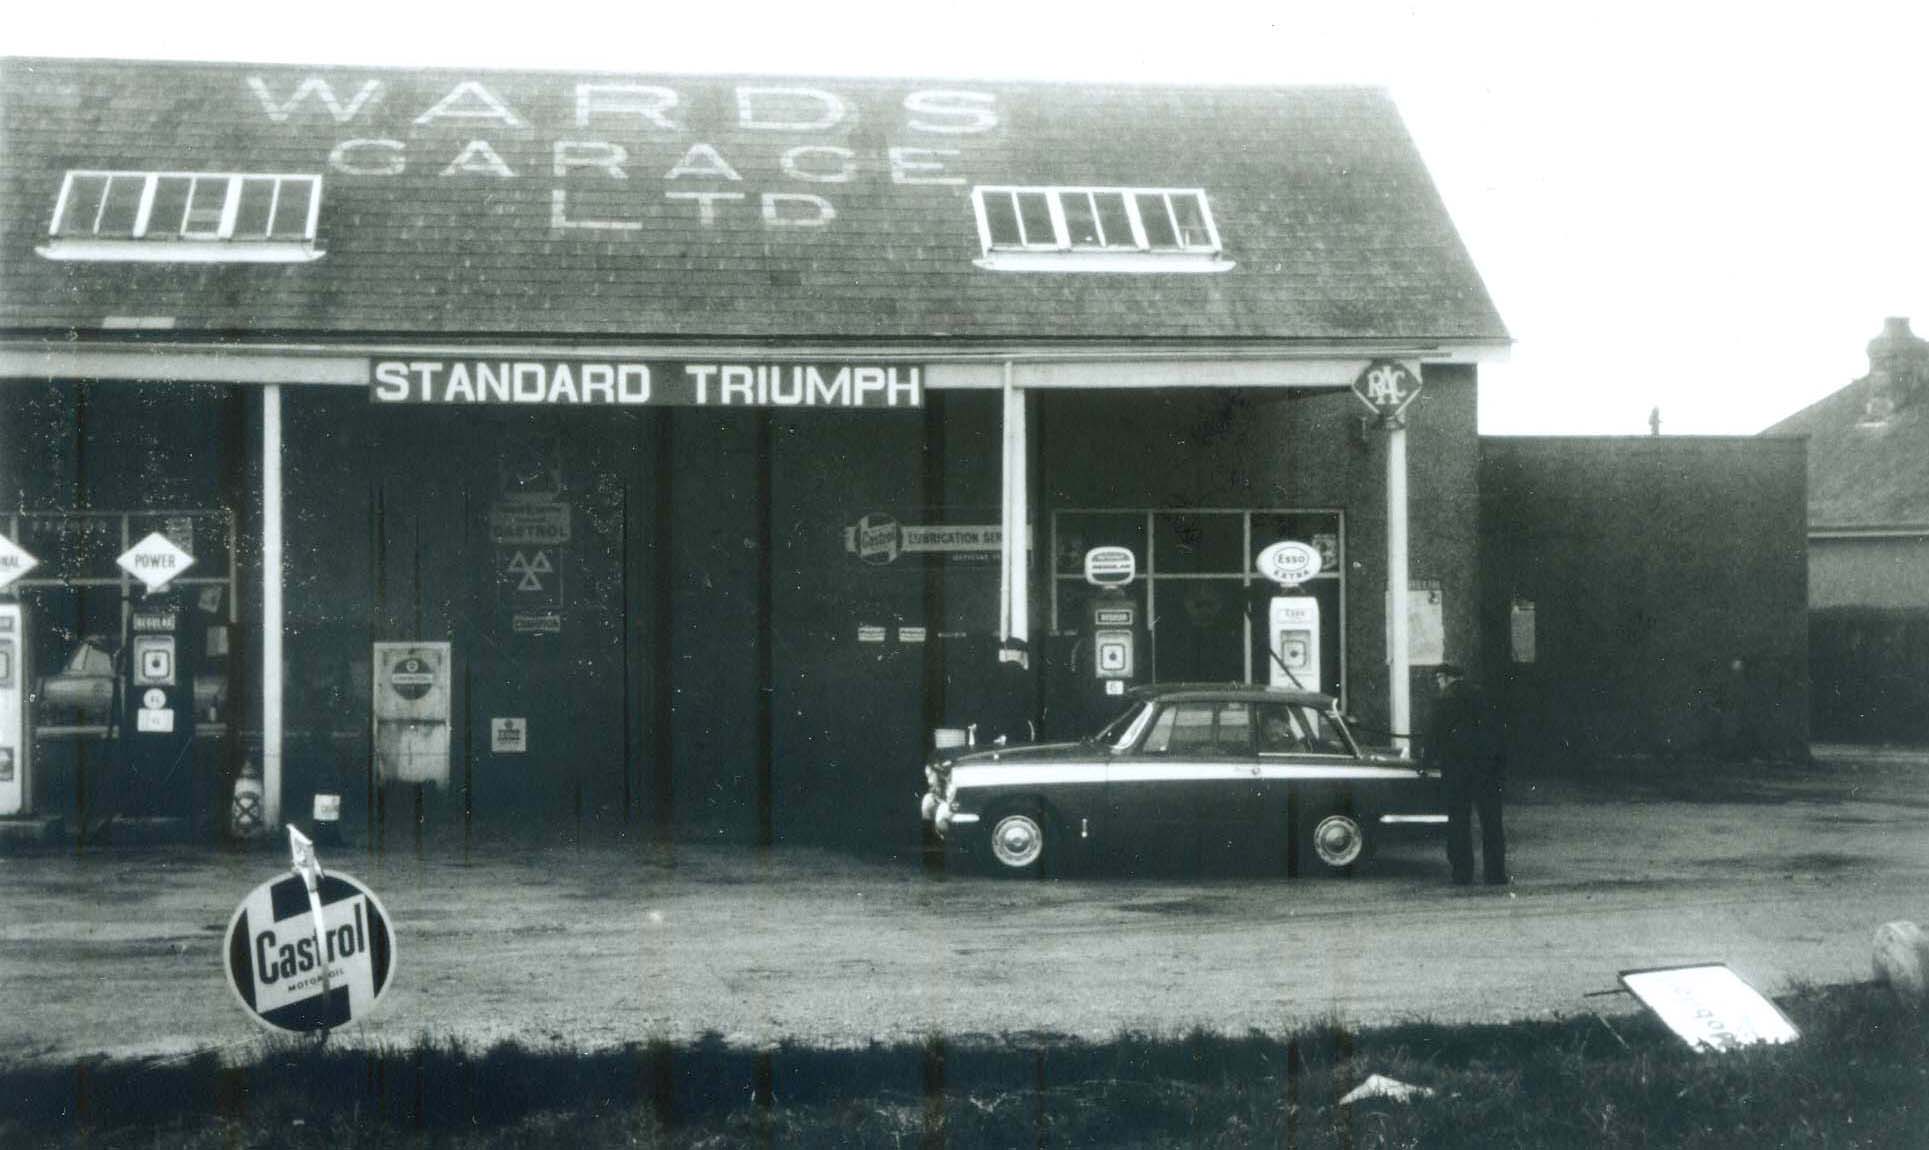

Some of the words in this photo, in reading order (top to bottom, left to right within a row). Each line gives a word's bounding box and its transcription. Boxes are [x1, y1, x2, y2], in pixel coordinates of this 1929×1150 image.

[247, 75, 998, 134] WARDS
[327, 138, 968, 186] GARAGE
[549, 188, 836, 231] LTD
[374, 360, 650, 403] STANDARD
[684, 363, 921, 406] TRIUMPH
[1367, 366, 1407, 405] RAC
[907, 531, 979, 545] LUBRICATION
[134, 554, 177, 570] POWER
[1273, 568, 1310, 581] EXTRA
[1278, 553, 1306, 565] Esso
[256, 902, 365, 985] Castrol
[327, 966, 345, 978] OIL
